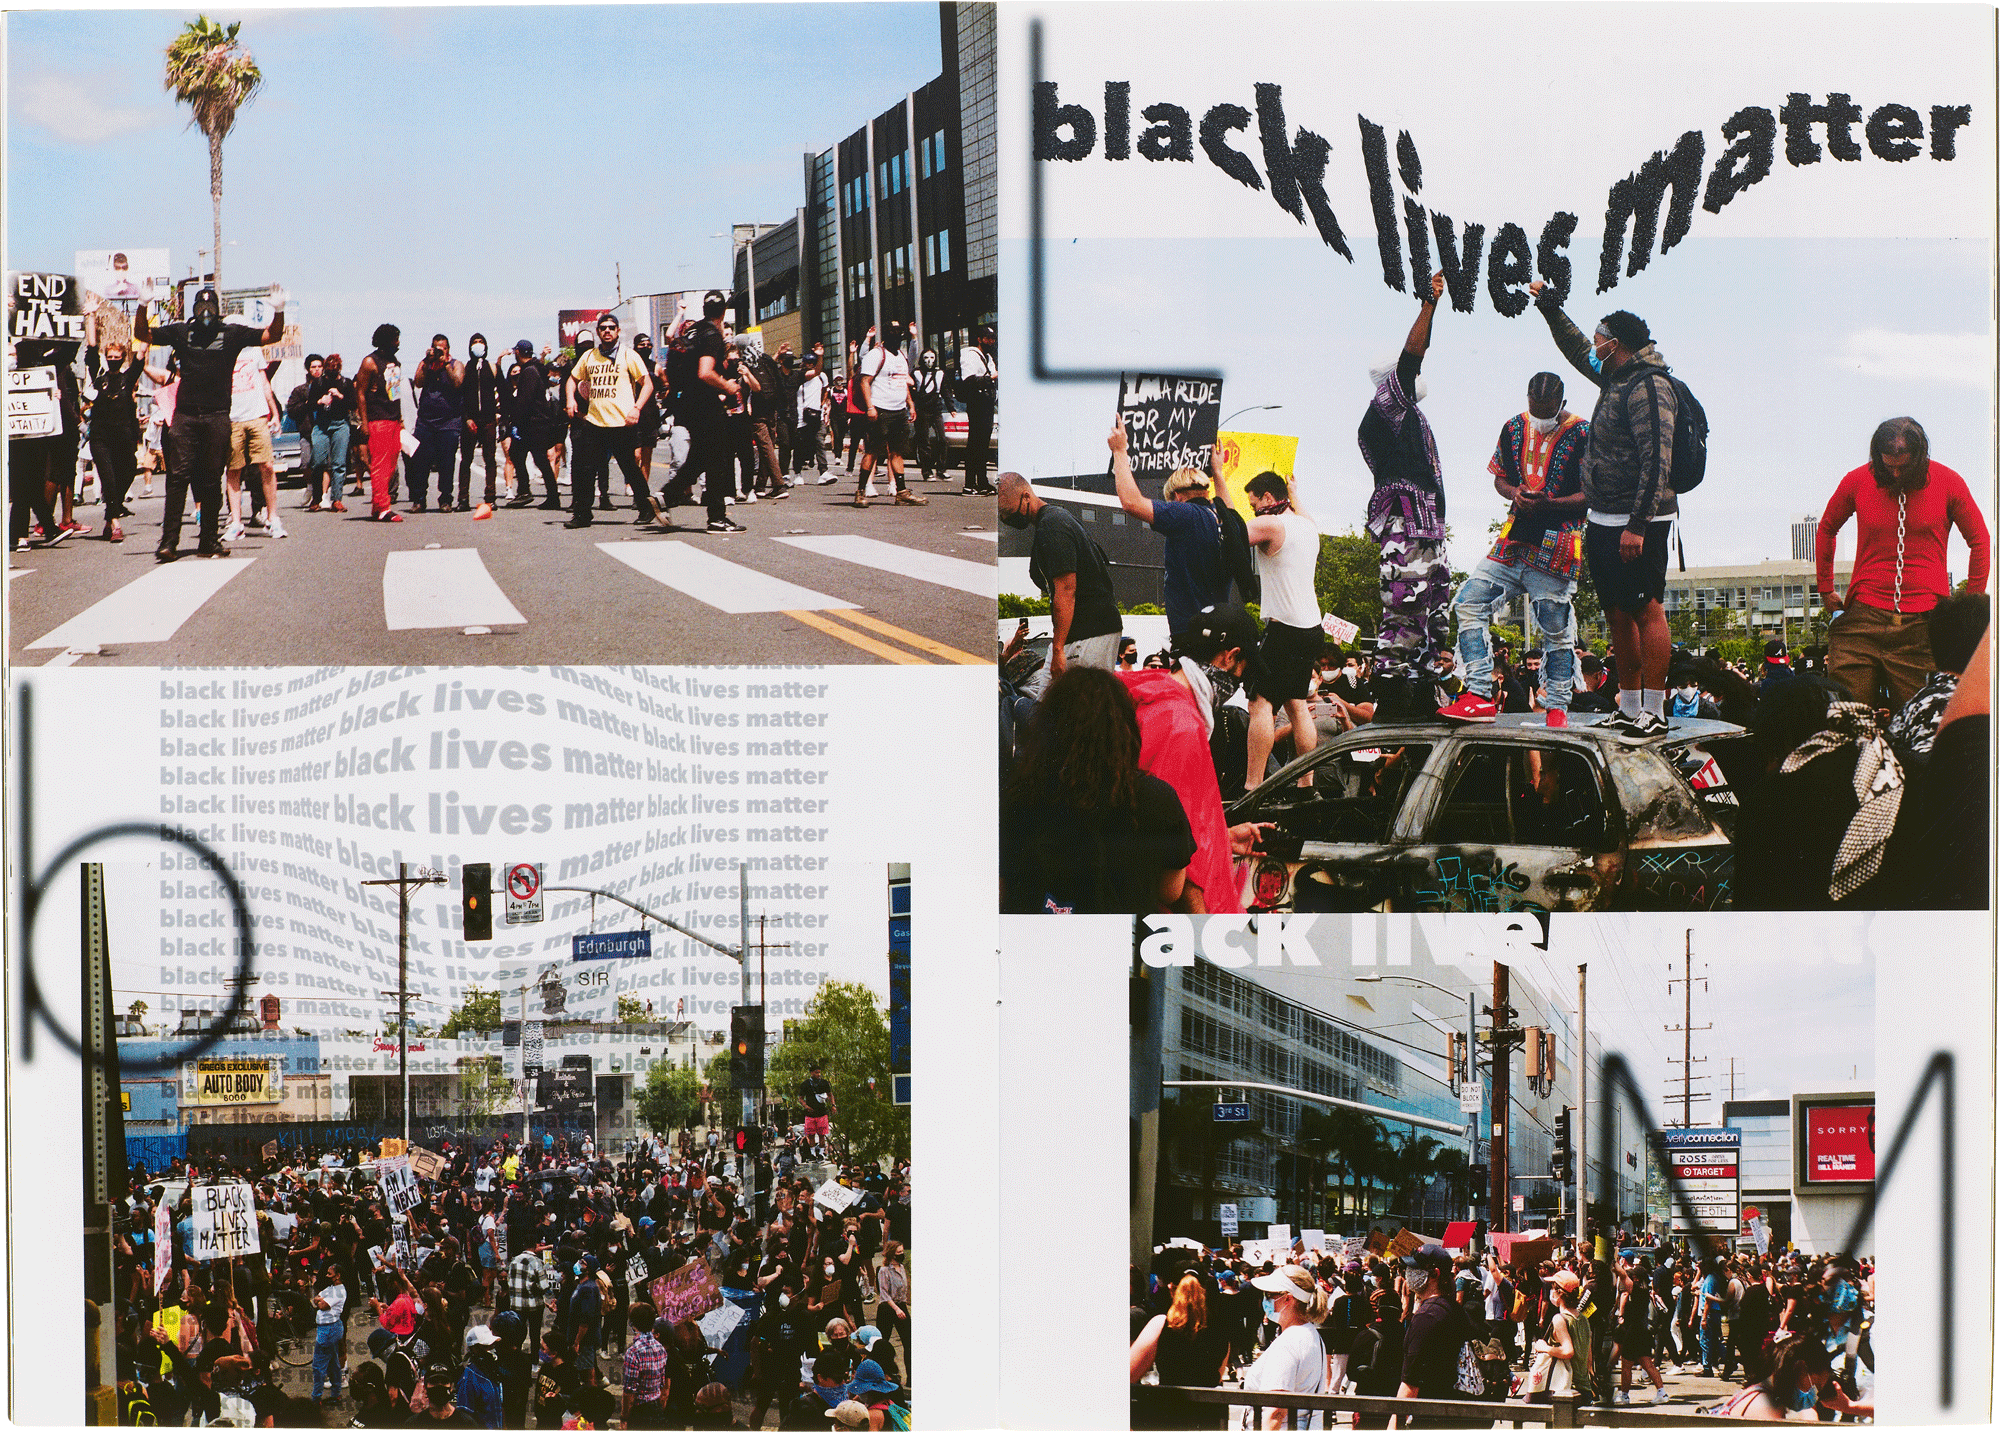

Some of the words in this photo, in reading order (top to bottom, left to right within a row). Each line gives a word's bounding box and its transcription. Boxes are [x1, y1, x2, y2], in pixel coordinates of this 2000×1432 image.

[19, 274, 66, 297] END
[28, 299, 63, 315] THE
[15, 310, 86, 337] HATE
[1122, 409, 1159, 432] FOR
[1168, 408, 1196, 431] MY
[578, 937, 645, 956] Edinburgh
[578, 971, 610, 986] SIR
[227, 1062, 270, 1072] EXCLUSIVE
[204, 1074, 232, 1094] AUTO
[235, 1074, 264, 1093] BODY
[1234, 1106, 1246, 1118] St
[1817, 1126, 1867, 1135] SORRY
[1679, 1154, 1707, 1163] ROSS
[1693, 1167, 1725, 1176] TARGET
[385, 1172, 400, 1197] AM
[400, 1168, 407, 1188] I
[206, 1186, 246, 1211] BLACK
[213, 1209, 248, 1231] LIVES
[200, 1230, 251, 1252] MATTER
